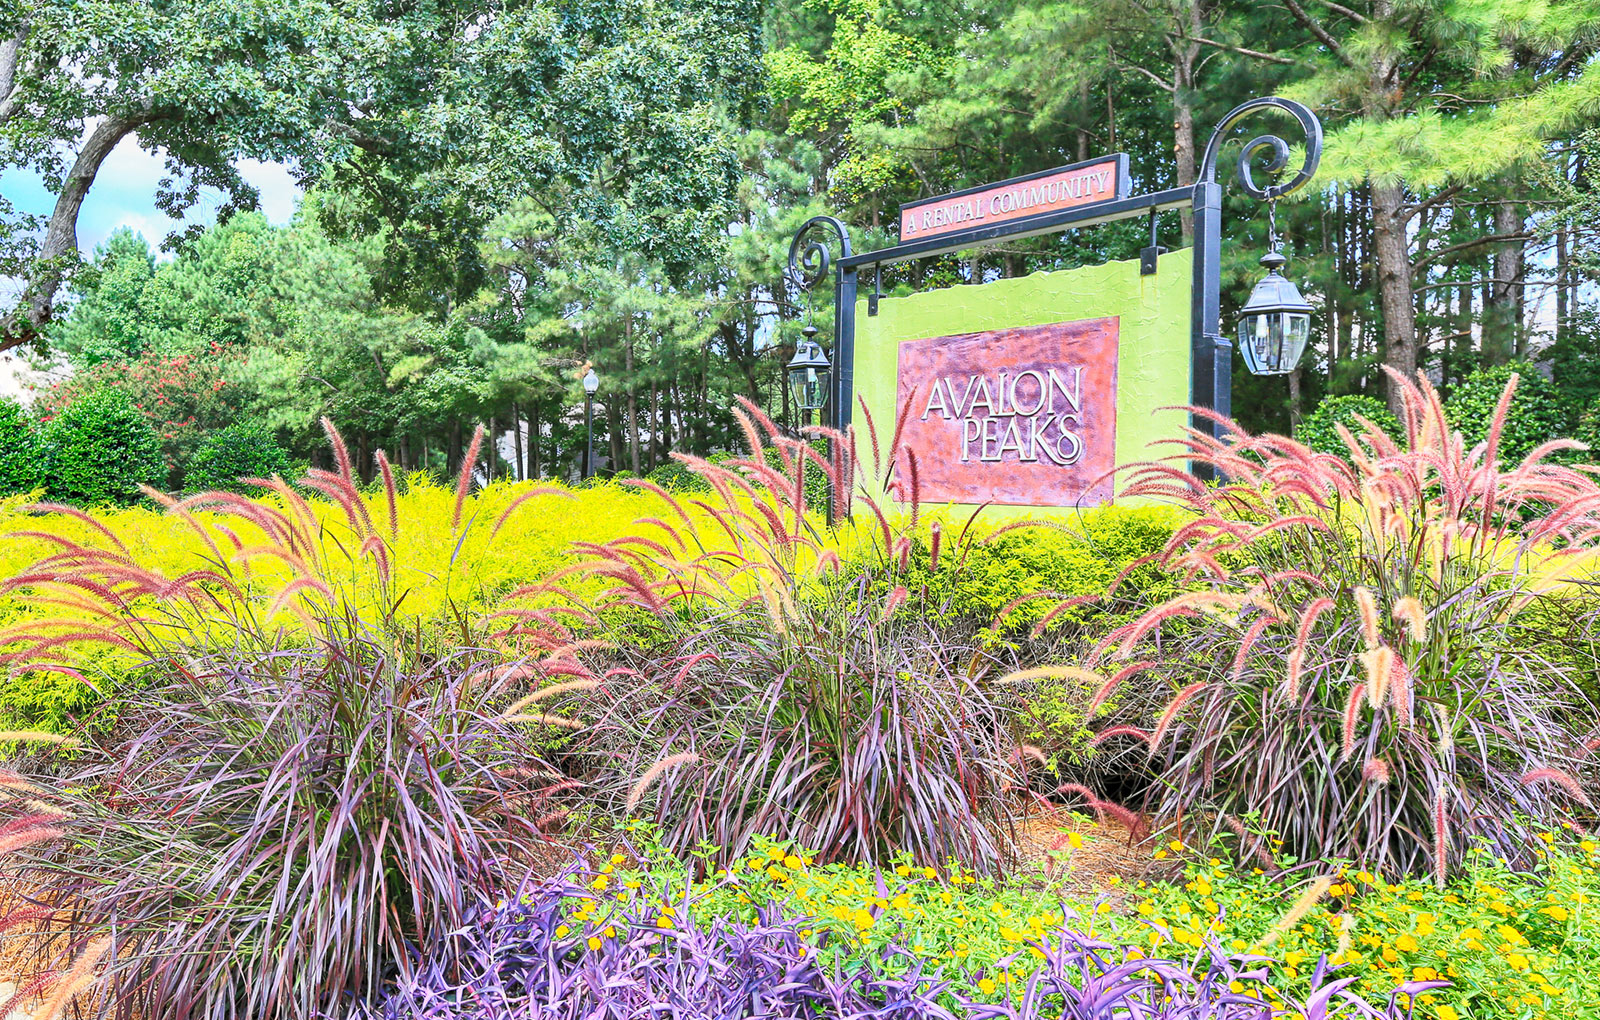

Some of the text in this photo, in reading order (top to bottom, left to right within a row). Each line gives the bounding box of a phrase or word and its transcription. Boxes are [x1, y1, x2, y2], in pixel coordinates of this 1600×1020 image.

[906, 171, 1109, 234] A RENTAL COMMUNITY
[921, 367, 1083, 420] AVALON
[961, 414, 1083, 466] PEAKS
